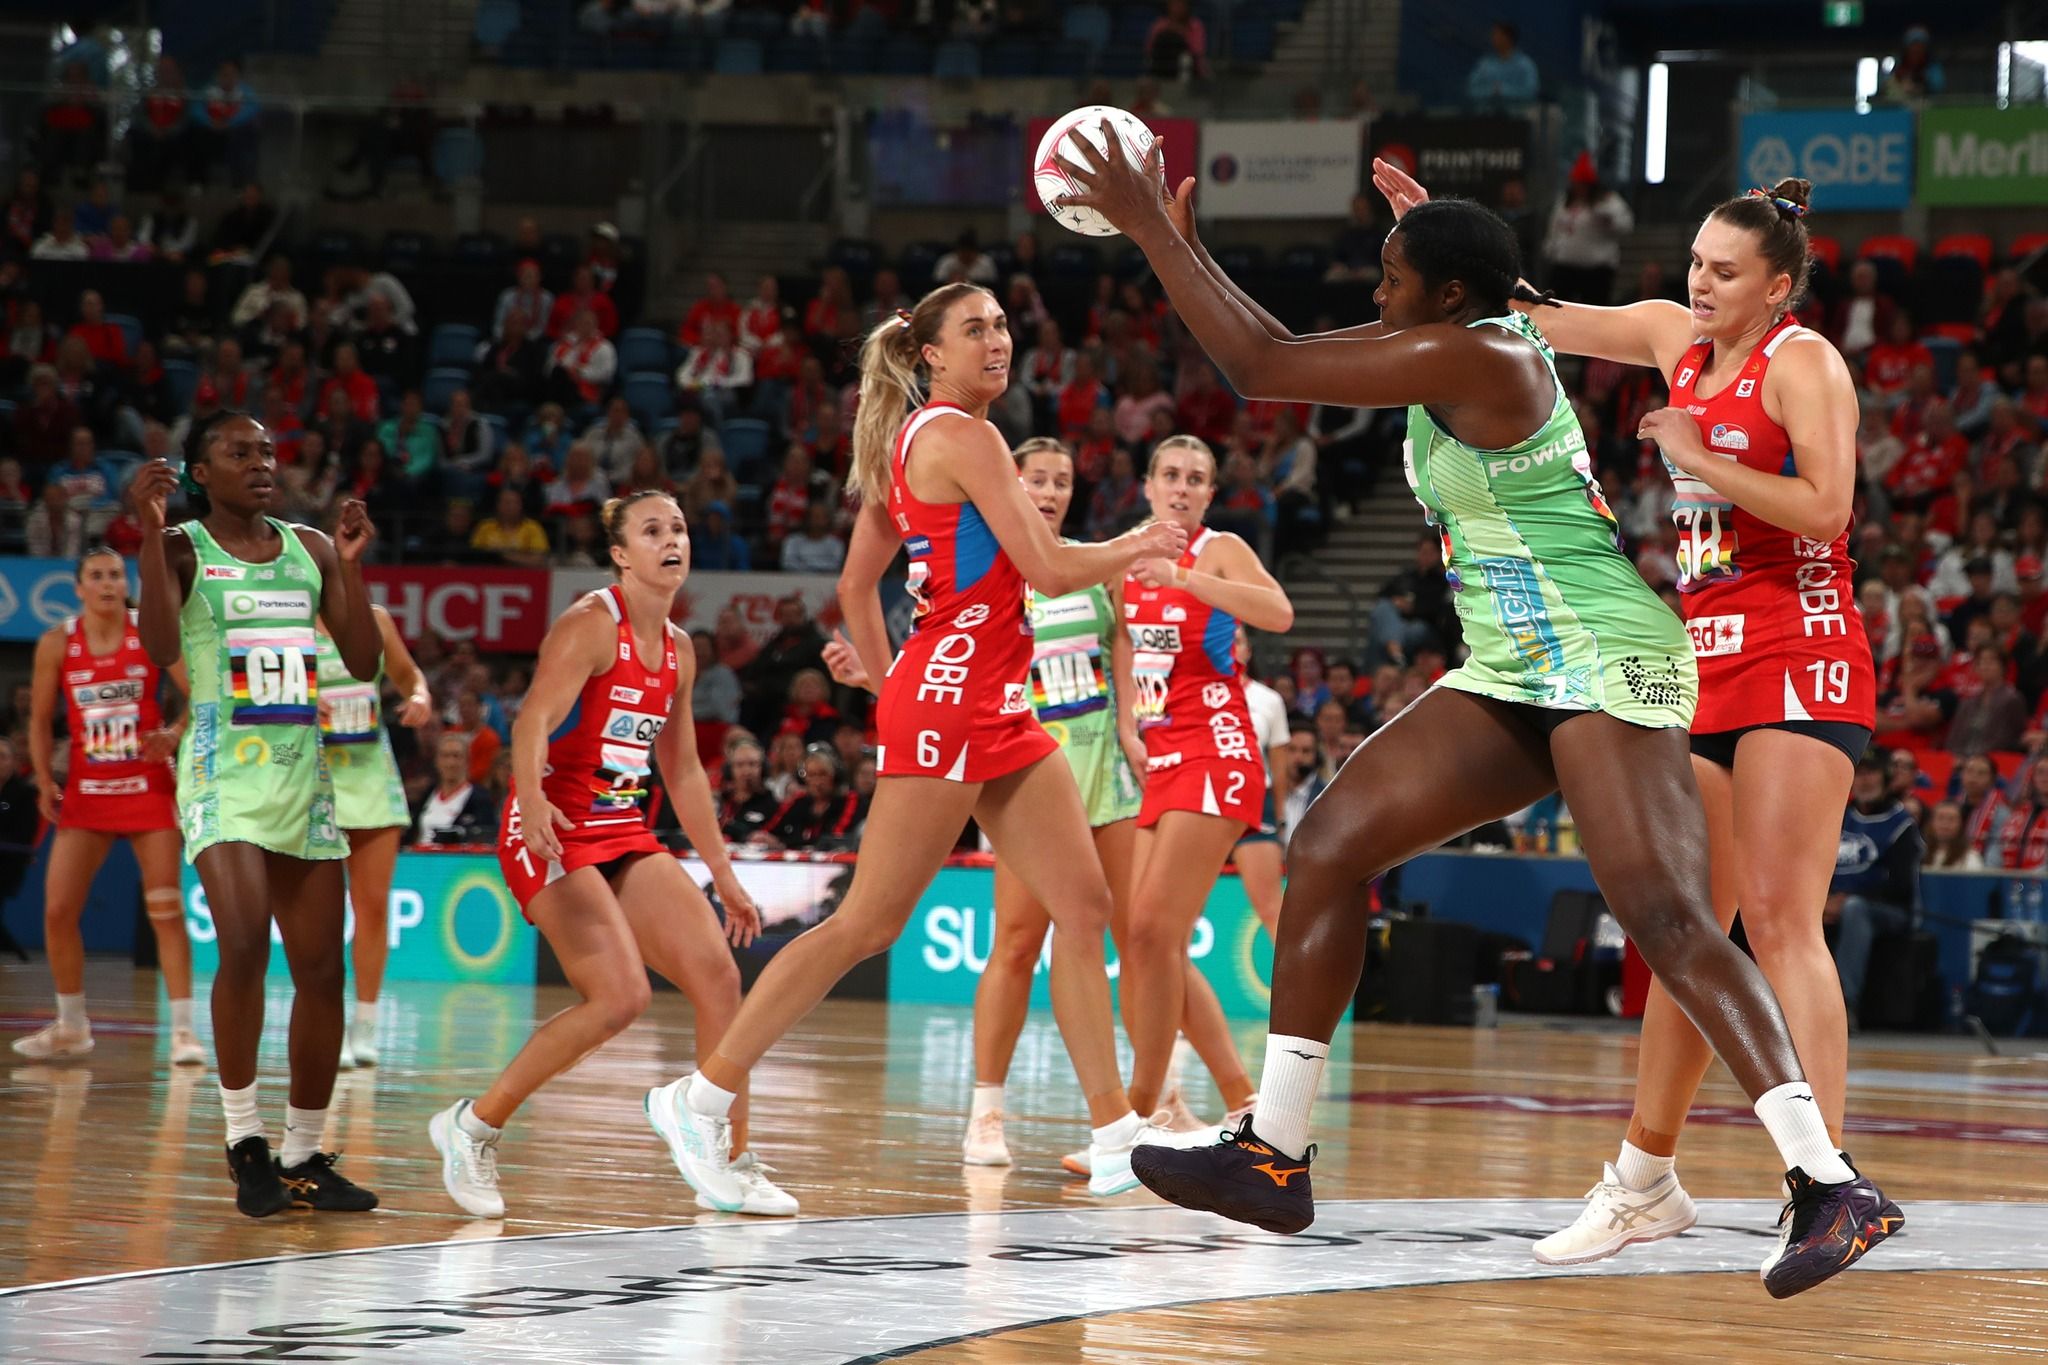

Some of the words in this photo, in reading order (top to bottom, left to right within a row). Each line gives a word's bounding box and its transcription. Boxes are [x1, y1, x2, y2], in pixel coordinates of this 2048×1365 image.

[1802, 133, 1907, 186] QBE
[371, 583, 531, 640] HCF
[1142, 628, 1179, 650] QBE
[1687, 619, 1717, 652] ed
[246, 646, 309, 707] GA
[917, 633, 976, 705] QBE
[1806, 659, 1850, 704] 19
[917, 730, 942, 768] 6
[1223, 771, 1246, 806] 2
[515, 846, 536, 878] 1
[140, 1322, 467, 1365] SH
